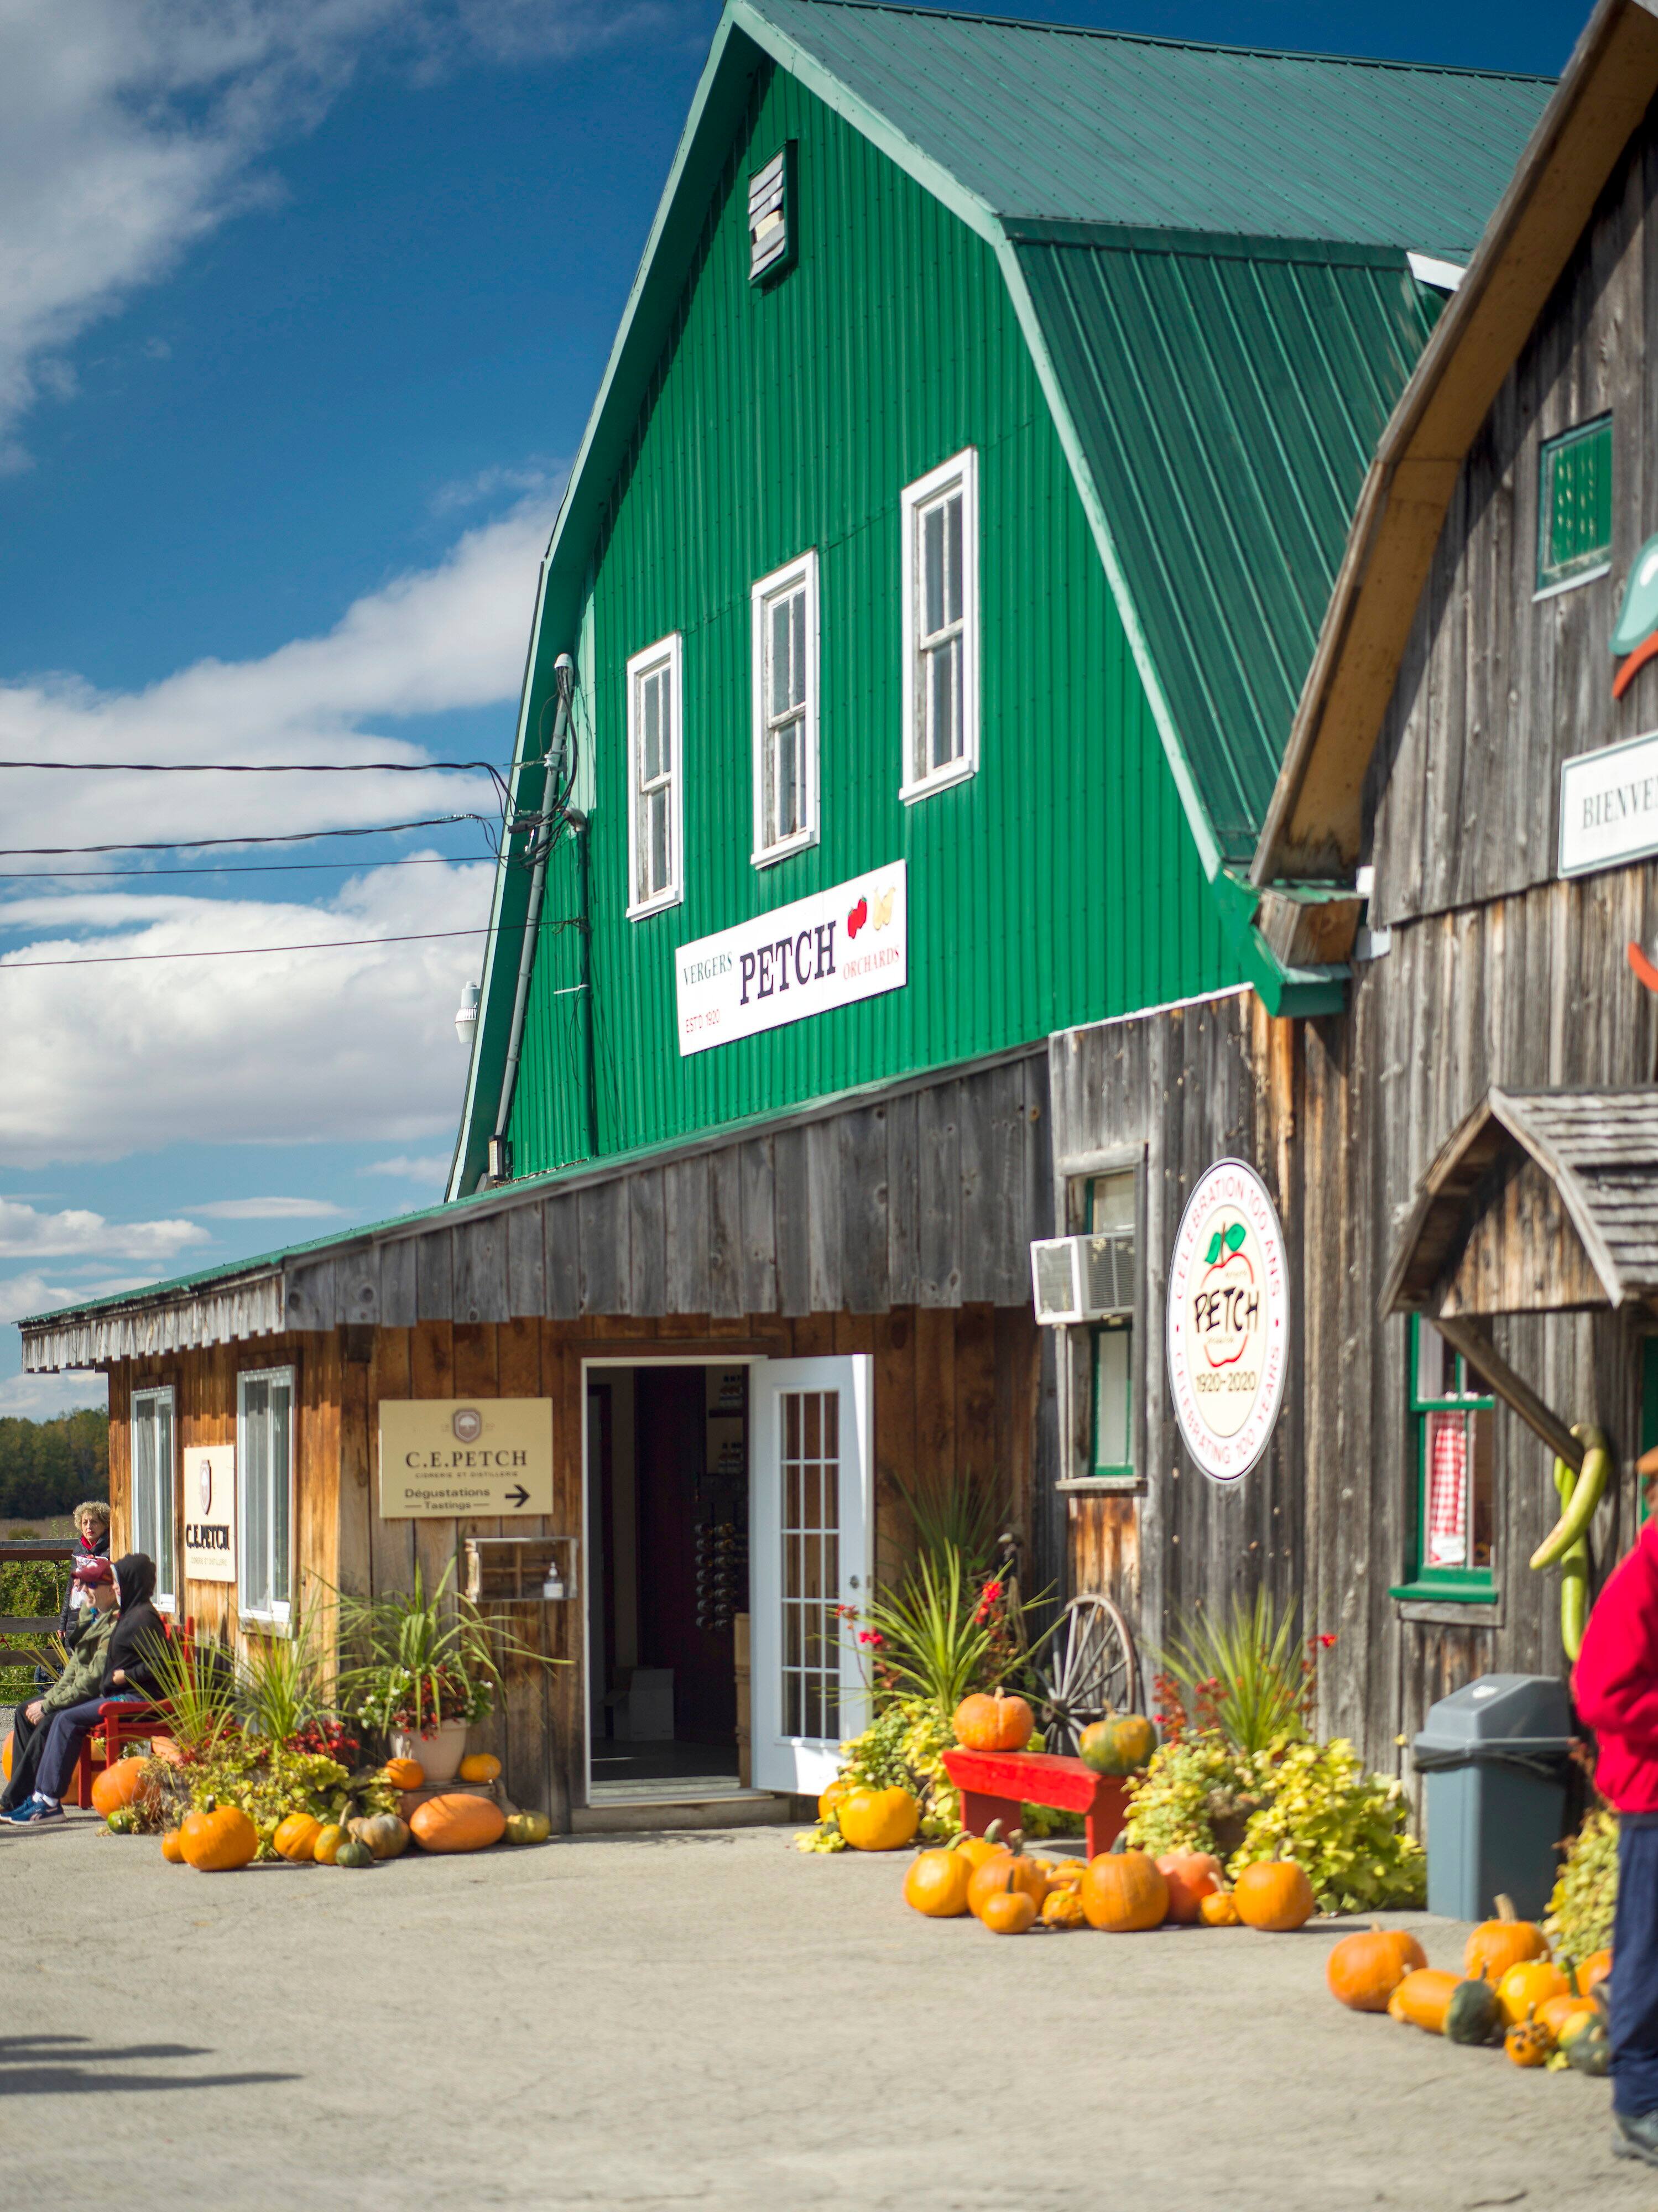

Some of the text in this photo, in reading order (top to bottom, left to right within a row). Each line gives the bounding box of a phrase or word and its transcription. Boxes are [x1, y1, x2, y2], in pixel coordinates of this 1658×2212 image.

[1582, 775, 1658, 830] BIENVE
[684, 951, 733, 986] VERGERS
[740, 920, 836, 1005] PETCH
[843, 946, 900, 980] ORCHARDS
[1248, 1189, 1268, 1230] 100
[1265, 1240, 1280, 1297] ANS
[1195, 1287, 1259, 1333] PETCH
[1196, 1371, 1256, 1392] 1920-2020
[1236, 1428, 1255, 1458] 100
[404, 1488, 491, 1499] Dégustations
[424, 1500, 471, 1510] Tastings
